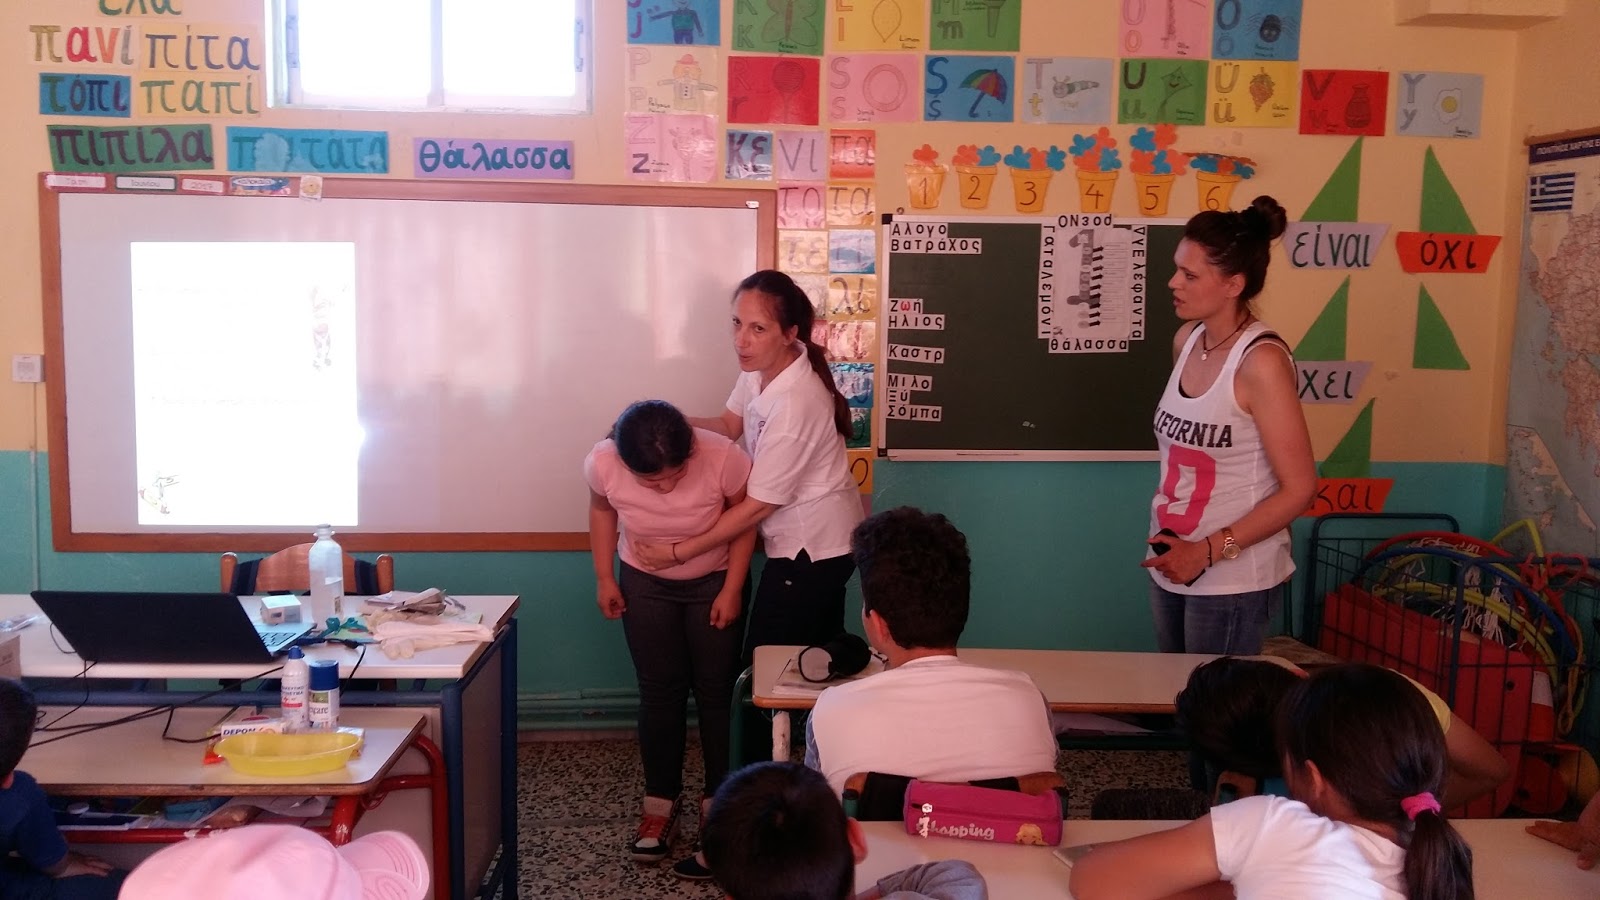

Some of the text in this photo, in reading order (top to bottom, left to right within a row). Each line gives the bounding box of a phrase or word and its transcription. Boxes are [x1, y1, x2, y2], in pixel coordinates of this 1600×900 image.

[29, 24, 134, 66] πανί
[145, 24, 260, 71] πίτα
[1026, 58, 1053, 90] T
[1123, 61, 1147, 90] U
[1215, 62, 1240, 94] Ü
[1304, 71, 1335, 101] V
[1403, 73, 1426, 104] Y
[42, 74, 128, 113] τόπι
[140, 74, 260, 115] παπί
[51, 126, 214, 167] πιπίλα
[919, 177, 928, 205] 1
[967, 175, 981, 201] 2
[1019, 181, 1038, 206] 3
[1085, 183, 1104, 210] 4
[1143, 185, 1161, 211] 5
[1205, 186, 1220, 212] 6
[1291, 224, 1371, 268] είναι
[1420, 233, 1478, 270] όχι
[890, 298, 921, 313] Ζωή
[888, 345, 943, 362] Καστρ
[887, 374, 930, 390] Μιλο
[888, 388, 908, 403] Ξύ
[887, 404, 940, 420] Σόμπα
